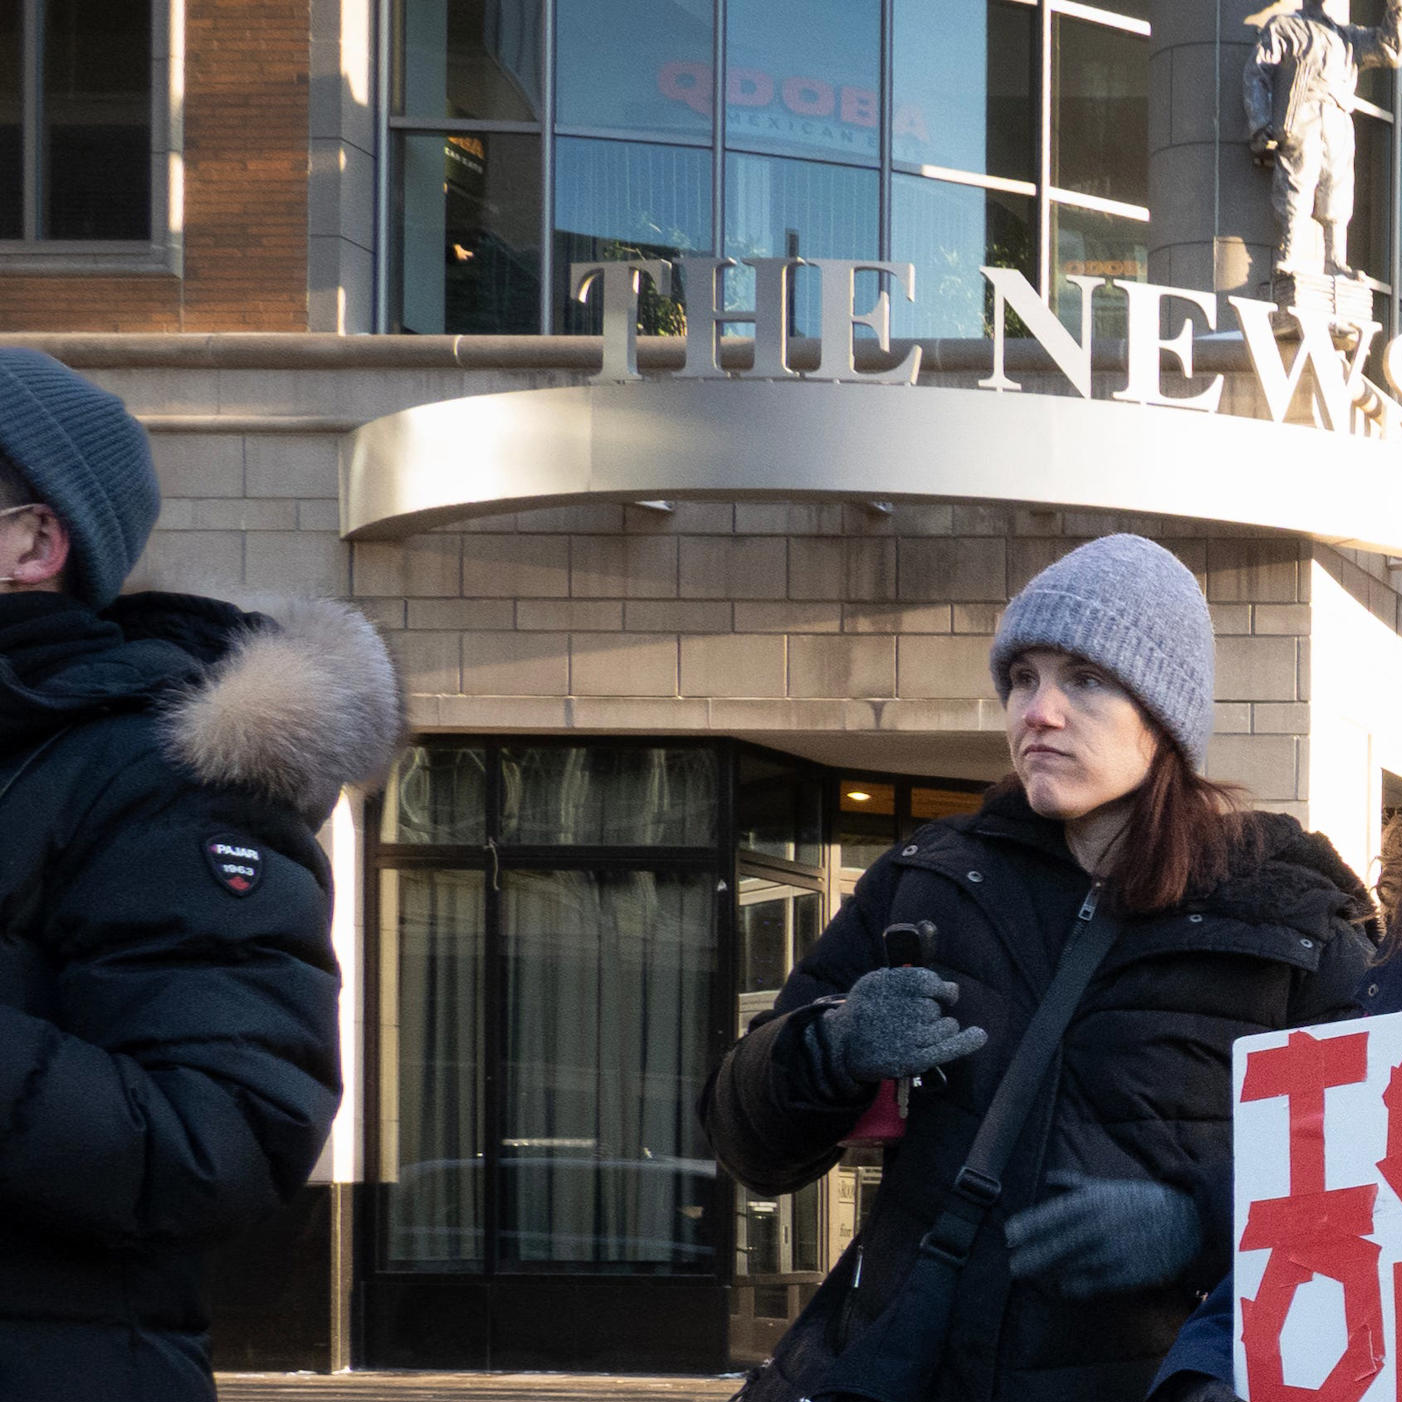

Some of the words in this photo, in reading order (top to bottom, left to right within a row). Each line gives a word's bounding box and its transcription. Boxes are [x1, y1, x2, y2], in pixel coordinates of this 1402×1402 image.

[657, 60, 929, 141] QDOBA
[571, 256, 924, 386] THE
[223, 864, 254, 876] 1963
